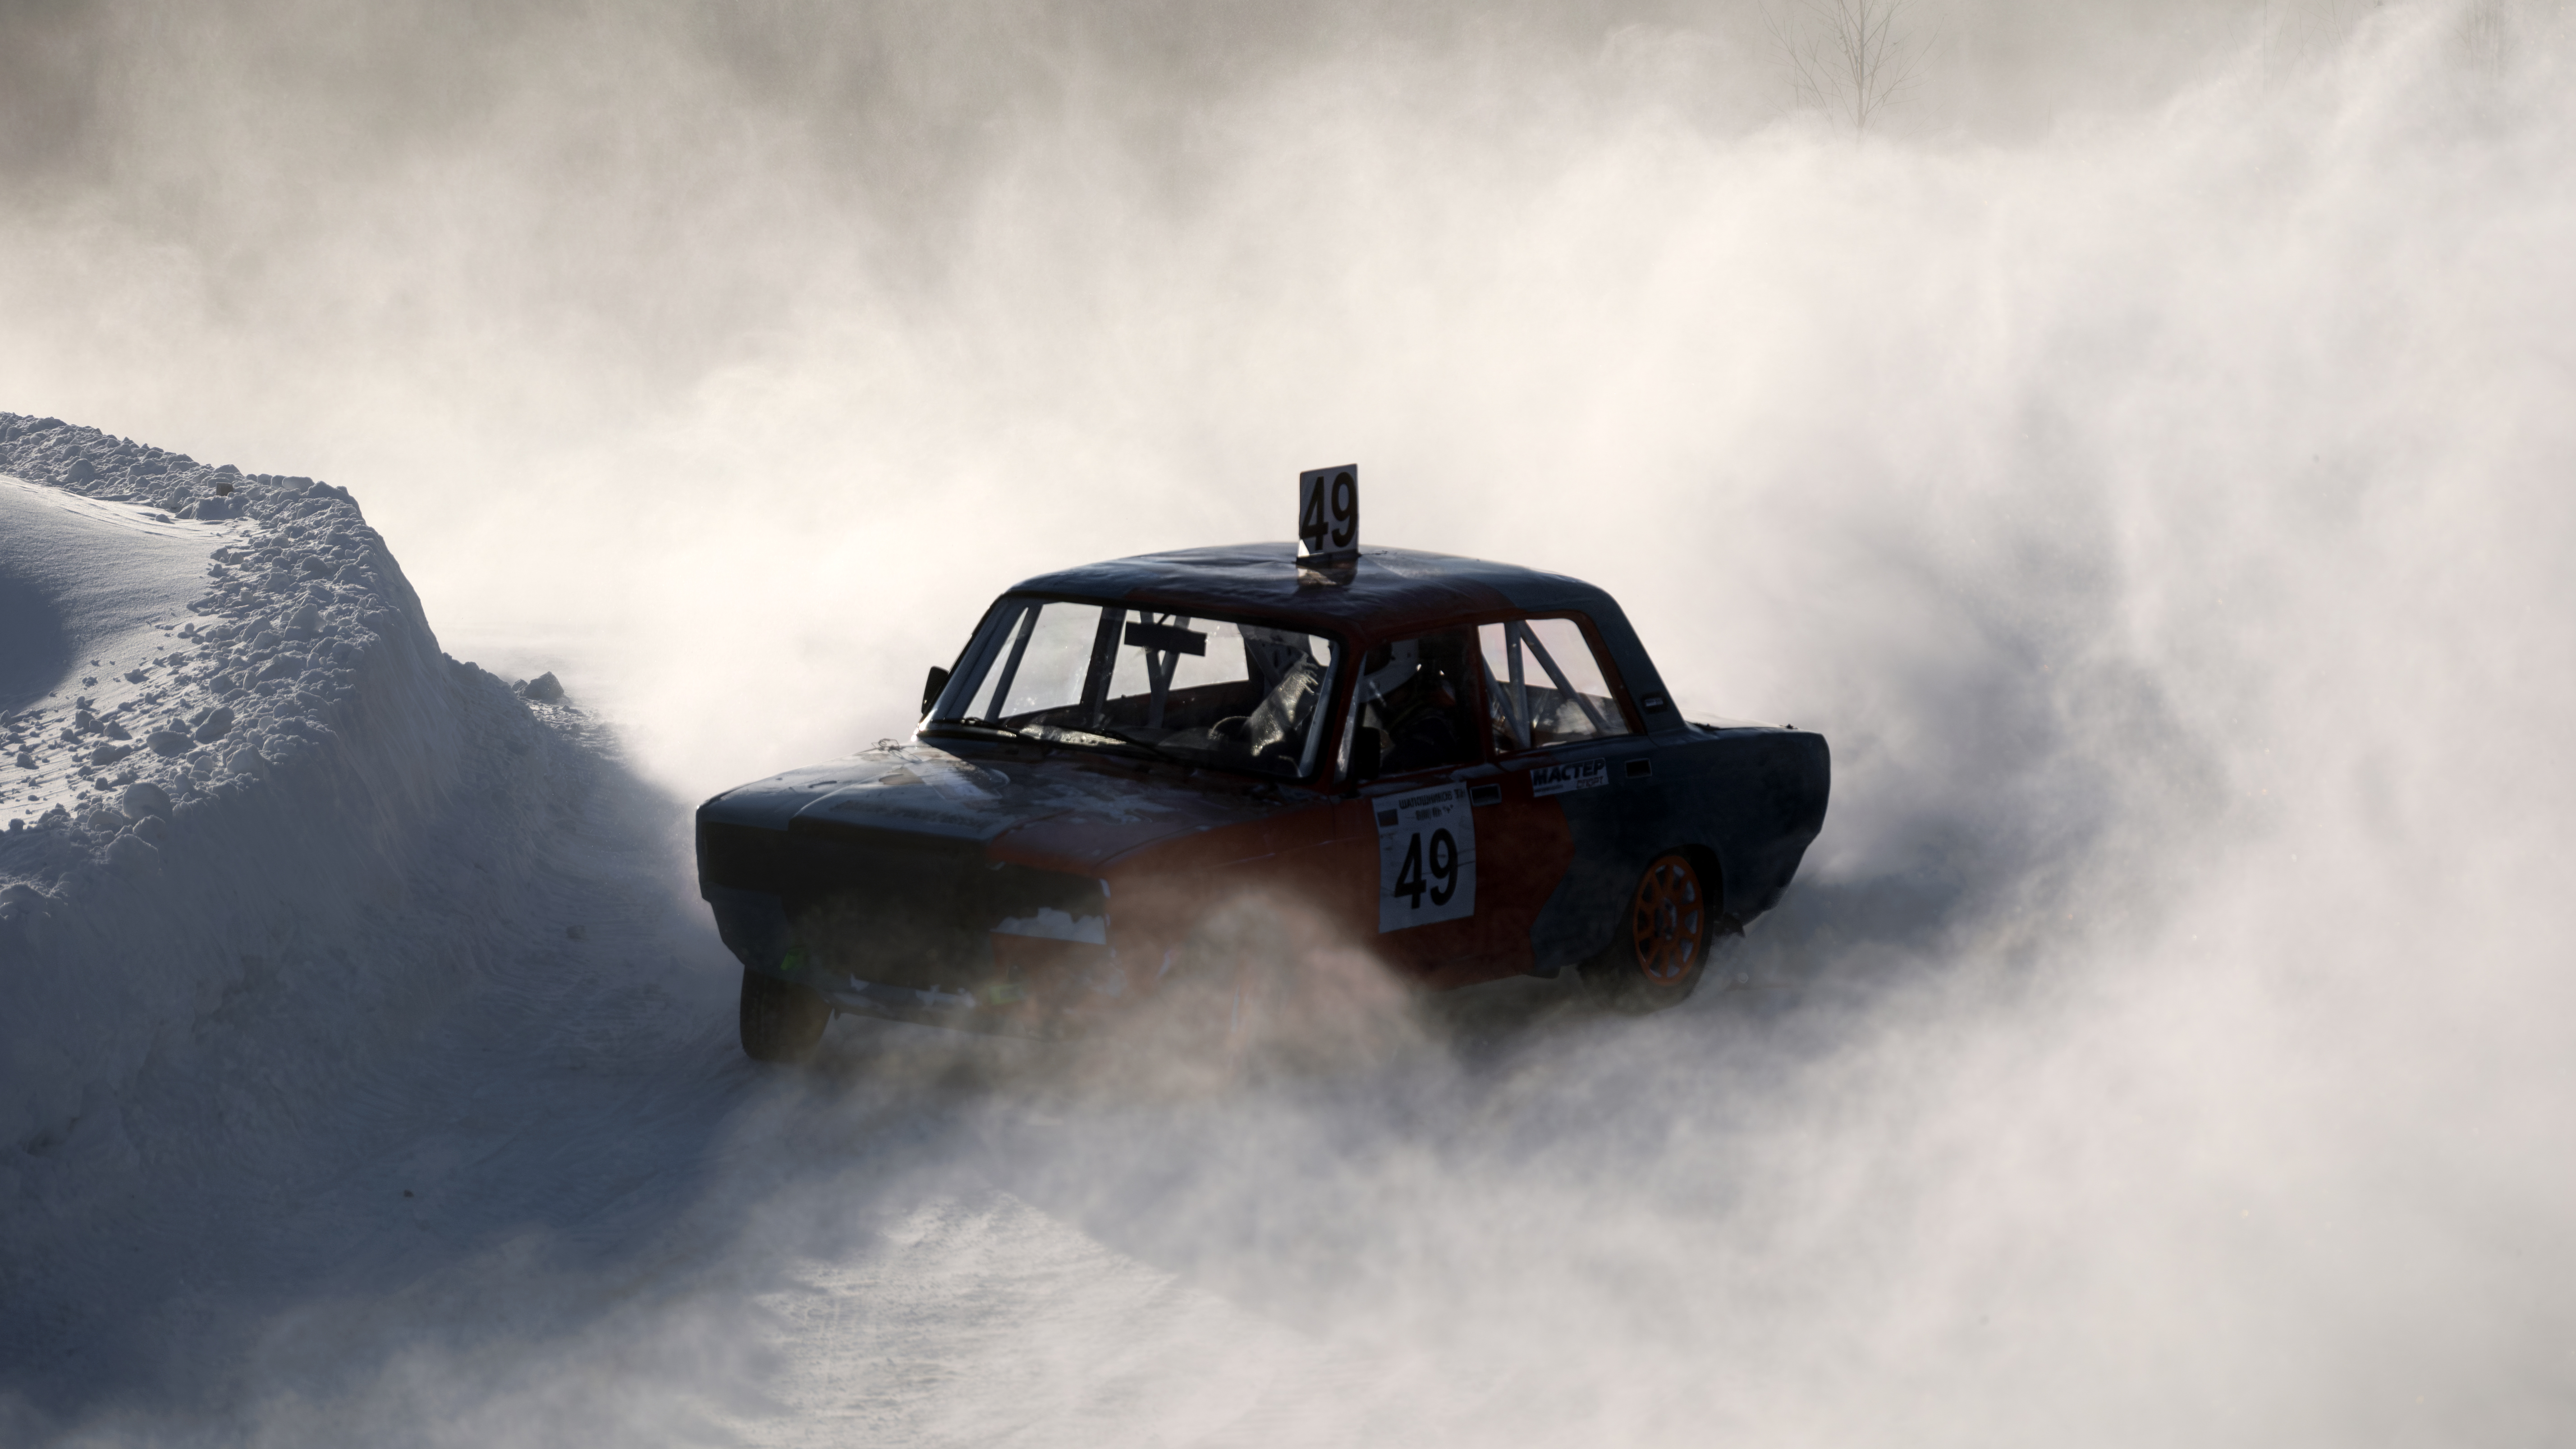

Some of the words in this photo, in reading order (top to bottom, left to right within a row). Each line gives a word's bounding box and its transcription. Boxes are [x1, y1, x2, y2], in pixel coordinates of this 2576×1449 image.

[1301, 472, 1358, 551] 49
[1533, 758, 1605, 785] МАСТЕР
[1394, 828, 1458, 909] 49
